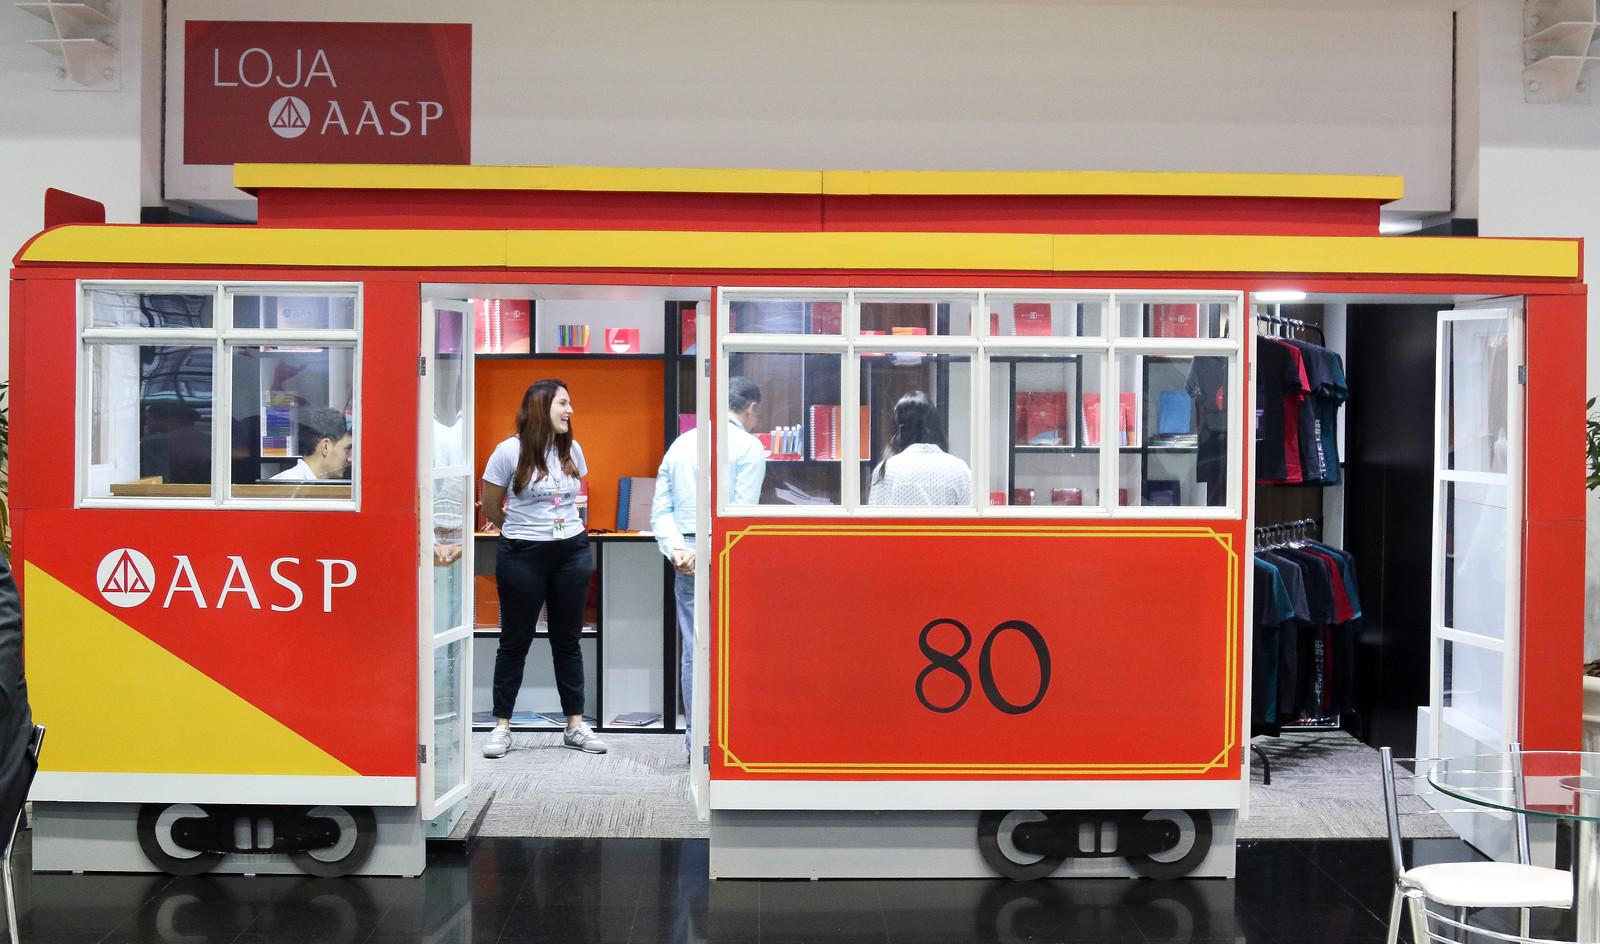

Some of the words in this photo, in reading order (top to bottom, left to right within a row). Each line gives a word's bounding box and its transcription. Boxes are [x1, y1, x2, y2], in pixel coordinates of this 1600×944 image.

[213, 48, 337, 88] LOJA
[320, 100, 443, 136] AASP
[163, 555, 358, 613] AASP
[915, 618, 1052, 714] 80
